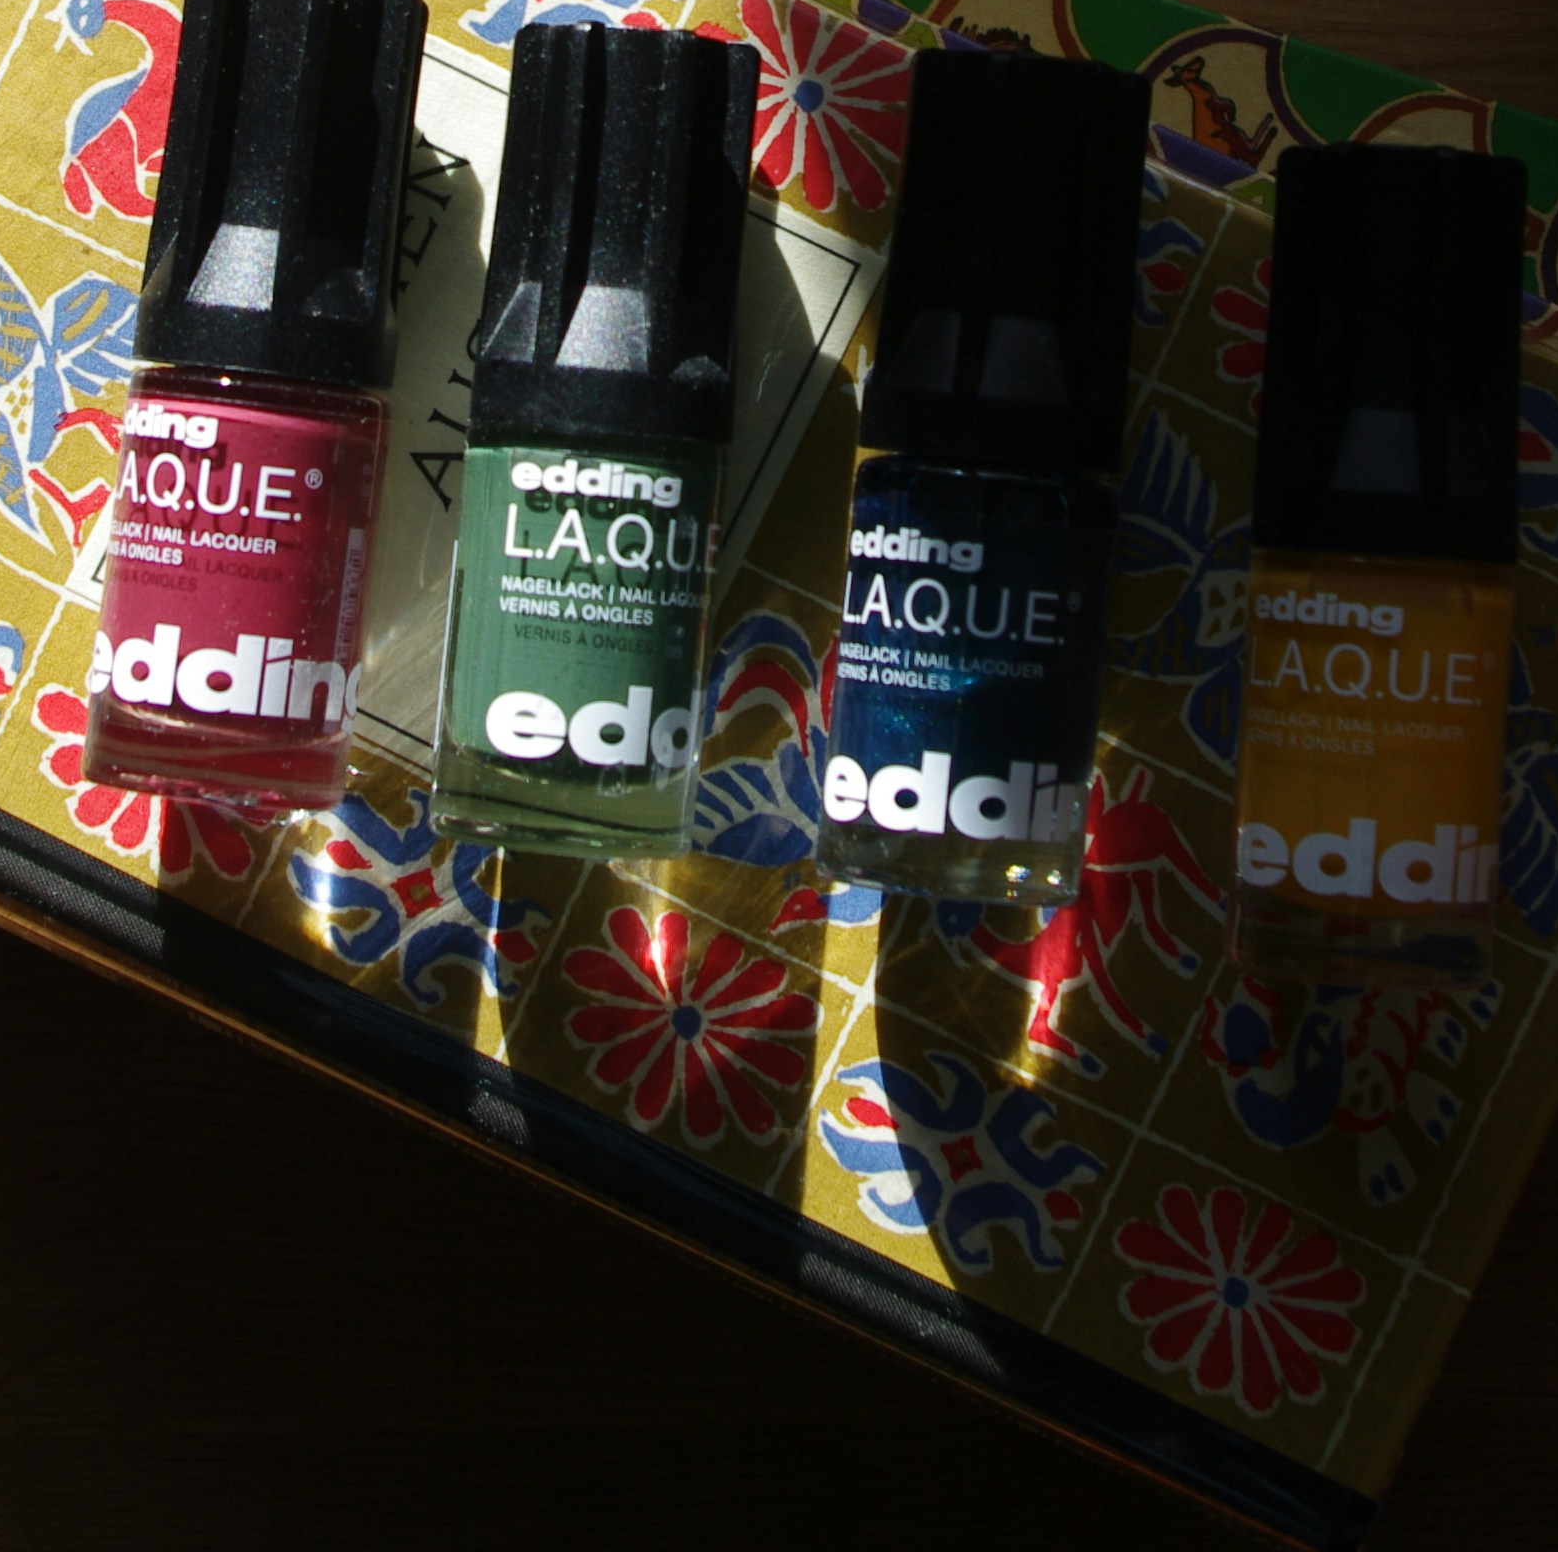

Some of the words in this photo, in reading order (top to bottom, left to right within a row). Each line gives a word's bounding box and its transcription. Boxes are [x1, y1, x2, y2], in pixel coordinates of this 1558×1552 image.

[510, 459, 683, 508] edding
[128, 543, 183, 566] ONGLES
[152, 525, 186, 545] NAIL
[190, 530, 277, 555] LACQUER
[850, 525, 984, 574] edding
[501, 575, 604, 601] NAGELLACK
[619, 580, 656, 605] NAIL
[499, 596, 560, 619] VERNIS
[581, 603, 654, 626] ONGLES
[1255, 590, 1404, 637] edding
[881, 667, 951, 692] ONGLES
[913, 650, 954, 672] NAIL
[959, 655, 1045, 680] LACQUER
